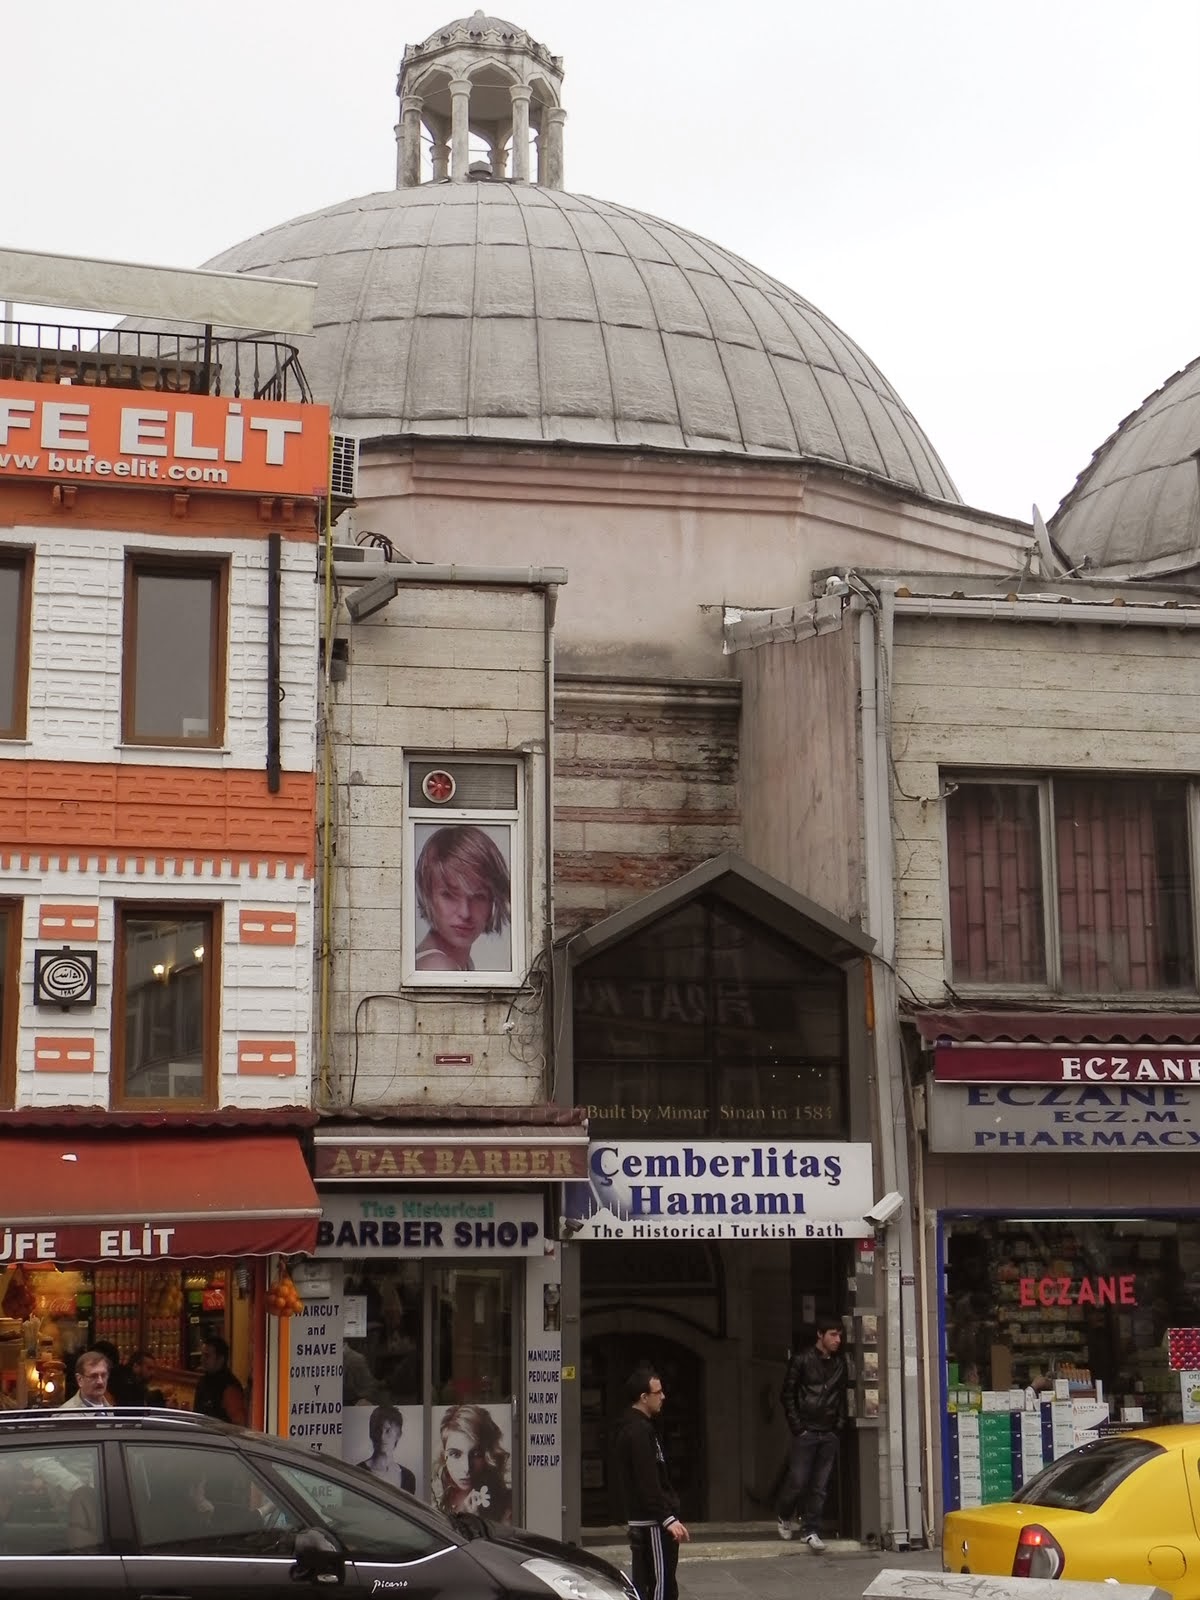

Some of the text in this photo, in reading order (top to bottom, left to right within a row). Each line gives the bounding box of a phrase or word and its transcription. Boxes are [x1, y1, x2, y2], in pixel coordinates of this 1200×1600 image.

[119, 403, 303, 466] ELİT
[967, 1086, 1191, 1106] ECZANE
[587, 1105, 833, 1123] Built by Mimar Sinan in 1584
[330, 1149, 575, 1176] ATAK BARBER
[590, 1146, 843, 1186] Çemberlitaş
[628, 1184, 807, 1216] Hamamı
[360, 1201, 495, 1219] The Historical
[317, 1221, 539, 1248] BARBER SHOP
[592, 1222, 844, 1238] The Historical Turkish Bath
[99, 1222, 175, 1257] ELİT
[1019, 1274, 1138, 1307] ECZANE
[307, 1324, 326, 1336] and
[296, 1343, 337, 1356] SHAVE
[528, 1350, 561, 1362] MANICURE
[528, 1370, 560, 1383] PEDICURE
[314, 1384, 321, 1396] Y
[528, 1392, 558, 1405] HAIR DRY
[528, 1412, 558, 1425] HAIR DYE
[289, 1422, 343, 1437] COIFFURE
[530, 1434, 555, 1446] WAXING
[528, 1455, 560, 1467] UPPER LIP
